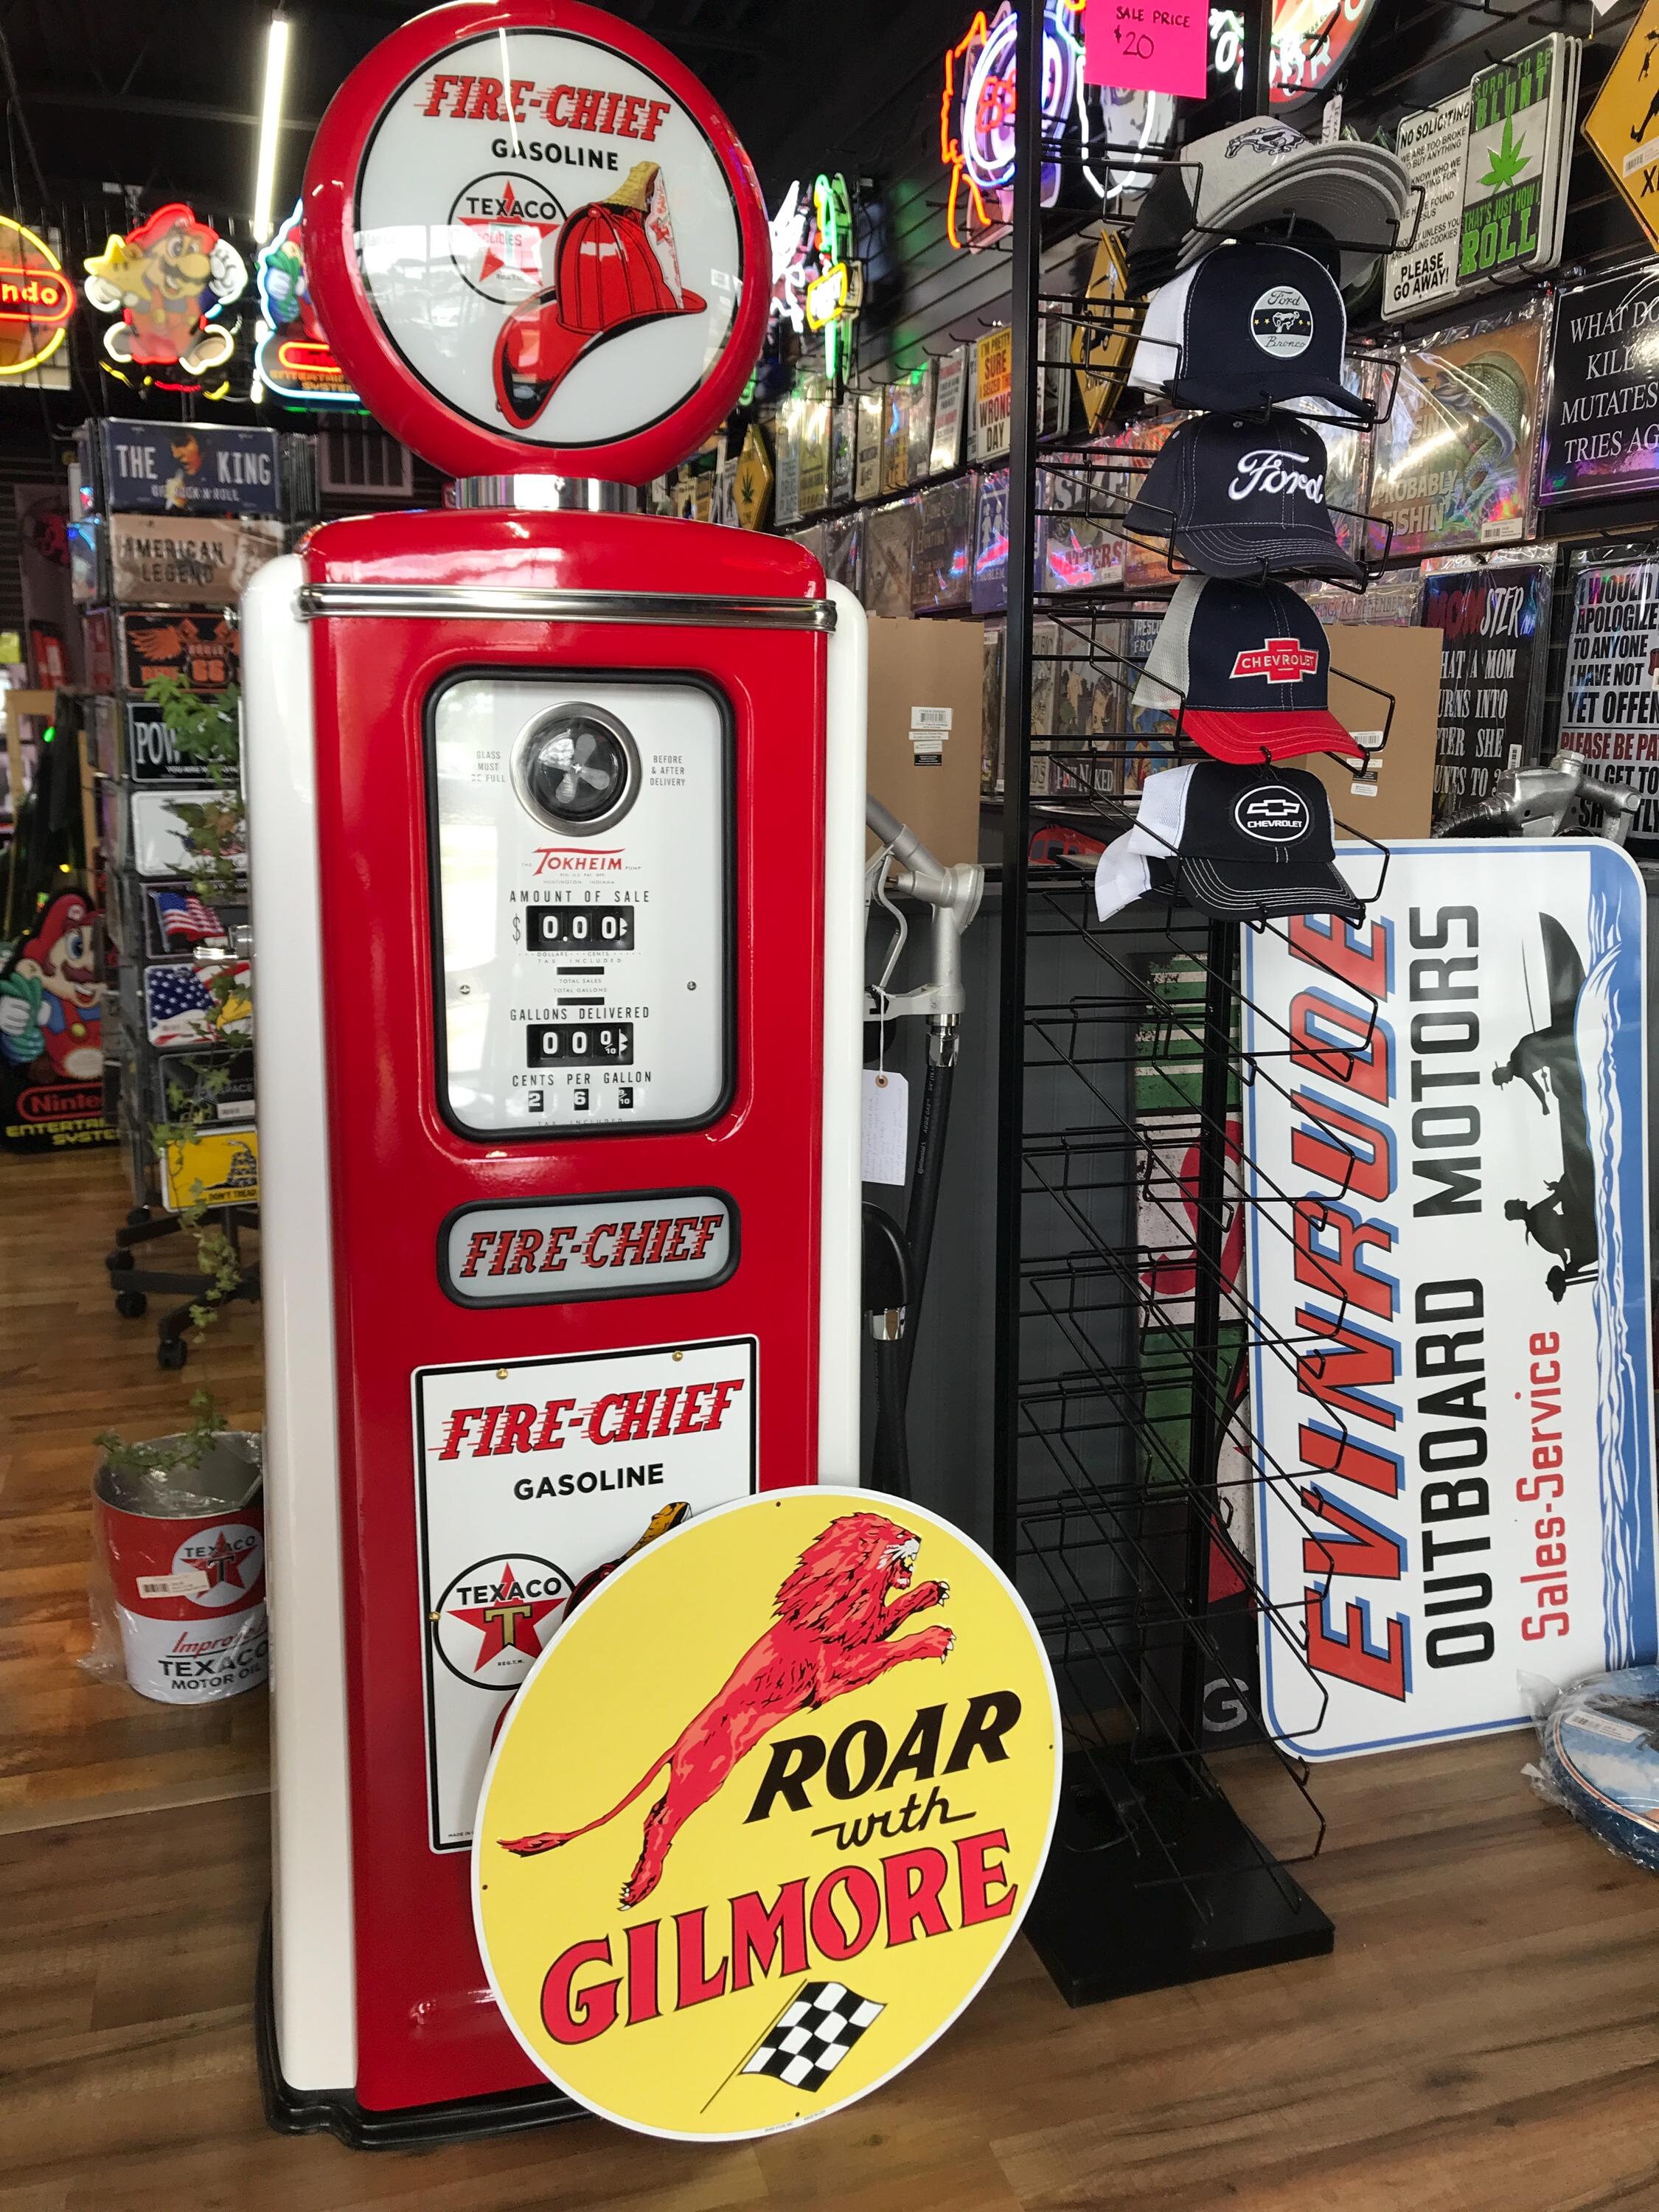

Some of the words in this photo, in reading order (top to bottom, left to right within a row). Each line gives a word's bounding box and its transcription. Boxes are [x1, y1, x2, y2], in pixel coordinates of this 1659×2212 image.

[1116, 6, 1144, 22] SALE
[1152, 10, 1191, 28] PRICE
[1114, 24, 1155, 60] $20
[1475, 68, 1511, 101] SORRY
[1517, 58, 1531, 79] TO
[417, 74, 671, 142] FIRE-CHIEF
[1475, 66, 1547, 131] BLUNT
[1401, 131, 1414, 150] NO
[1416, 101, 1470, 143] SOLICITING
[492, 138, 619, 172] GASOLINE
[1411, 147, 1425, 159] ARE
[1427, 140, 1441, 152] TOO
[1441, 127, 1467, 145] BROKE
[1413, 156, 1426, 170] BUY
[1427, 139, 1462, 162] ANYTHING
[1433, 162, 1449, 176] WHO
[1450, 156, 1462, 168] WE
[1442, 169, 1457, 182] FOR
[466, 195, 557, 220] TEXACO
[1430, 191, 1455, 206] FOUND
[1493, 194, 1513, 223] JUST
[1515, 184, 1534, 212] HOW
[1422, 222, 1447, 239] UNLESS
[1430, 227, 1458, 246] COOKIES
[1458, 206, 1537, 276] ROLL
[1401, 251, 1444, 282] PLEASE
[1267, 291, 1301, 306] Ford
[1394, 283, 1410, 301] GO
[1412, 267, 1449, 299] AWAY!
[1570, 304, 1628, 344] WHAT
[1264, 335, 1306, 348] Bronco
[978, 392, 1012, 428] WRONG
[1560, 381, 1659, 426] MUTATES
[987, 421, 1005, 452] DAY
[1564, 430, 1624, 465] TRIES
[115, 444, 159, 480] THE
[216, 451, 272, 487] KING
[1228, 449, 1324, 504] Ford
[1374, 470, 1459, 506] PROBABLY
[119, 536, 226, 565] AMERICAN
[1576, 603, 1659, 634] APOLOGIZE
[1241, 652, 1315, 669] CHEVROLET
[1573, 637, 1590, 659] TO
[1590, 634, 1649, 659] ANYONE
[1439, 650, 1465, 679] HAT
[1484, 649, 1517, 679] MOM
[1576, 664, 1612, 686] HAVE
[1613, 662, 1645, 686] NOT
[1437, 689, 1471, 720] URNS
[1475, 689, 1508, 720] INTO
[1568, 692, 1600, 723] YET
[476, 751, 501, 761] GLASS
[1475, 728, 1505, 758] SHE
[1561, 732, 1612, 759] PLEASE
[1613, 733, 1635, 760] BE
[477, 762, 499, 771] MUST
[651, 767, 658, 775] &
[660, 765, 685, 775] AFTER
[653, 754, 683, 765] BEFORE
[486, 773, 506, 783] FULL
[650, 778, 686, 787] DELIVERY
[1079, 763, 1113, 793] NKED
[1470, 766, 1489, 797] TO
[1247, 820, 1303, 829] CHEVROLET
[531, 847, 626, 877] TOKHEIM
[509, 890, 571, 902] AMOUNT
[584, 890, 601, 902] OF
[614, 890, 650, 902] SALE
[510, 1009, 568, 1021] GALLONS
[579, 1006, 650, 1020] DELIVERED
[1409, 905, 1483, 1218] MOTORS
[512, 1074, 554, 1088] CENTS
[567, 1073, 591, 1085] PER
[603, 1071, 652, 1084] GALLON
[574, 1091, 586, 1105] 6
[459, 1214, 724, 1278] FIRE-CHIEF
[1288, 914, 1413, 1703] EVINRUDE
[431, 1378, 745, 1461] FIRE-CHIEF
[514, 1463, 664, 1500] GASOLINE
[1415, 1279, 1495, 1669] OUTBOARD
[1516, 1330, 1571, 1642] Sales-Service
[184, 1535, 257, 1558] TEXACO
[456, 1576, 562, 1606] TEXACO
[172, 1672, 234, 1691] MOTOR
[240, 1663, 262, 1682] OIL
[743, 1689, 1023, 1825] ROAR
[811, 1785, 976, 1852] with
[540, 1828, 1019, 2045] GILMORE
